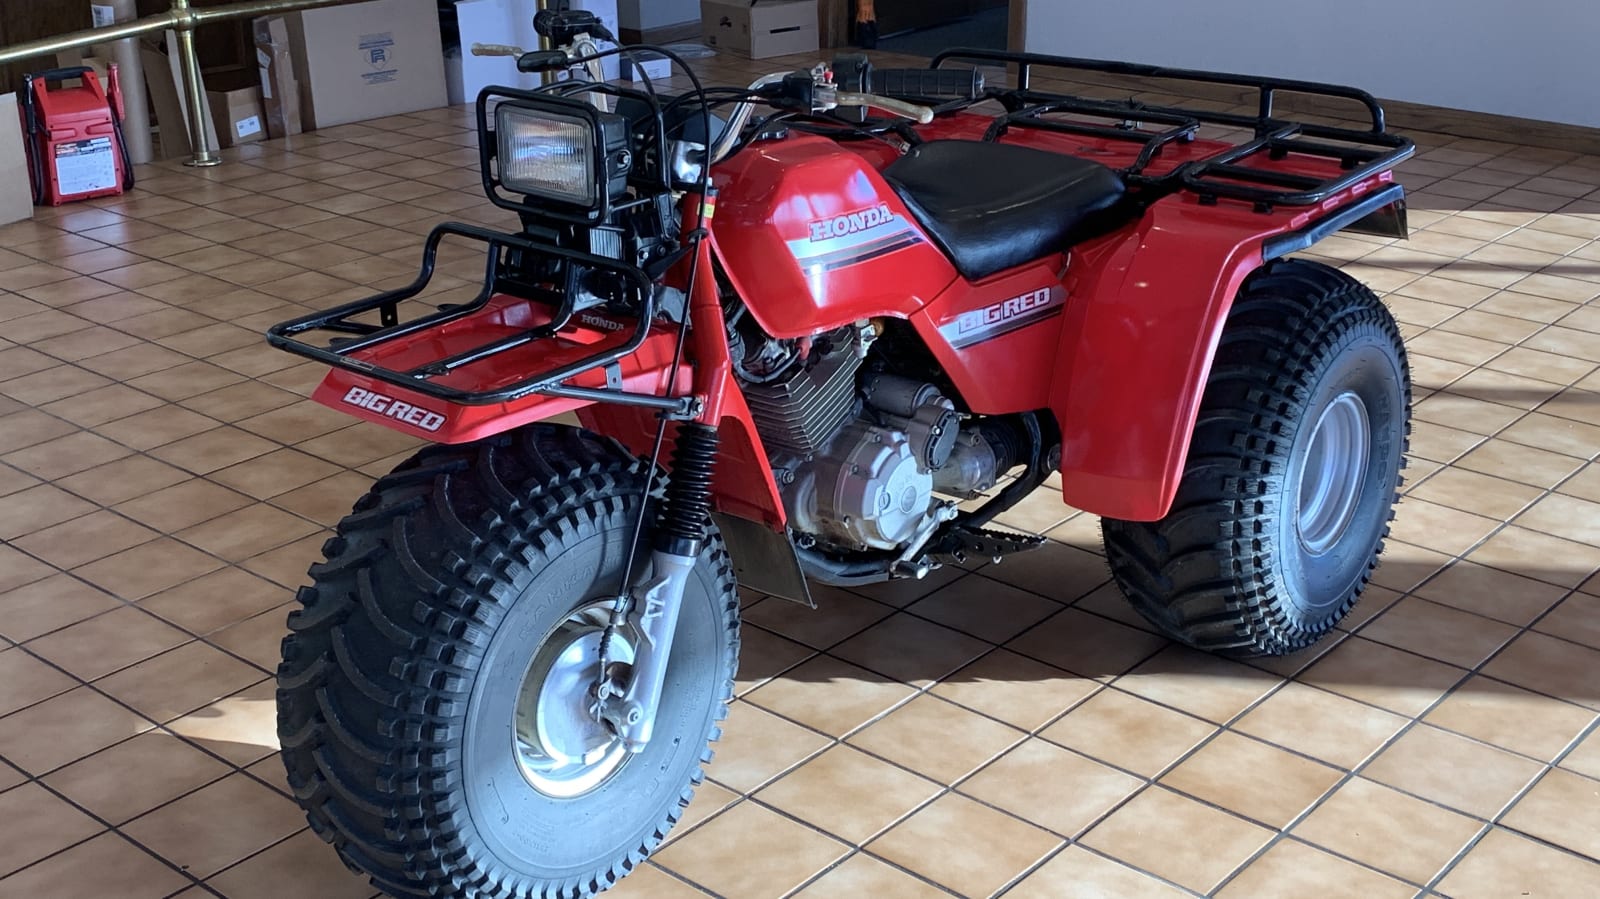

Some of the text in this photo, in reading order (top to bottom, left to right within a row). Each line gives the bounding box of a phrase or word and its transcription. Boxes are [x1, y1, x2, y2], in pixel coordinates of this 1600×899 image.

[809, 204, 894, 242] HONDA
[581, 314, 625, 331] HONDA
[958, 286, 1052, 334] BIG RED
[342, 386, 446, 432] BIG RED
